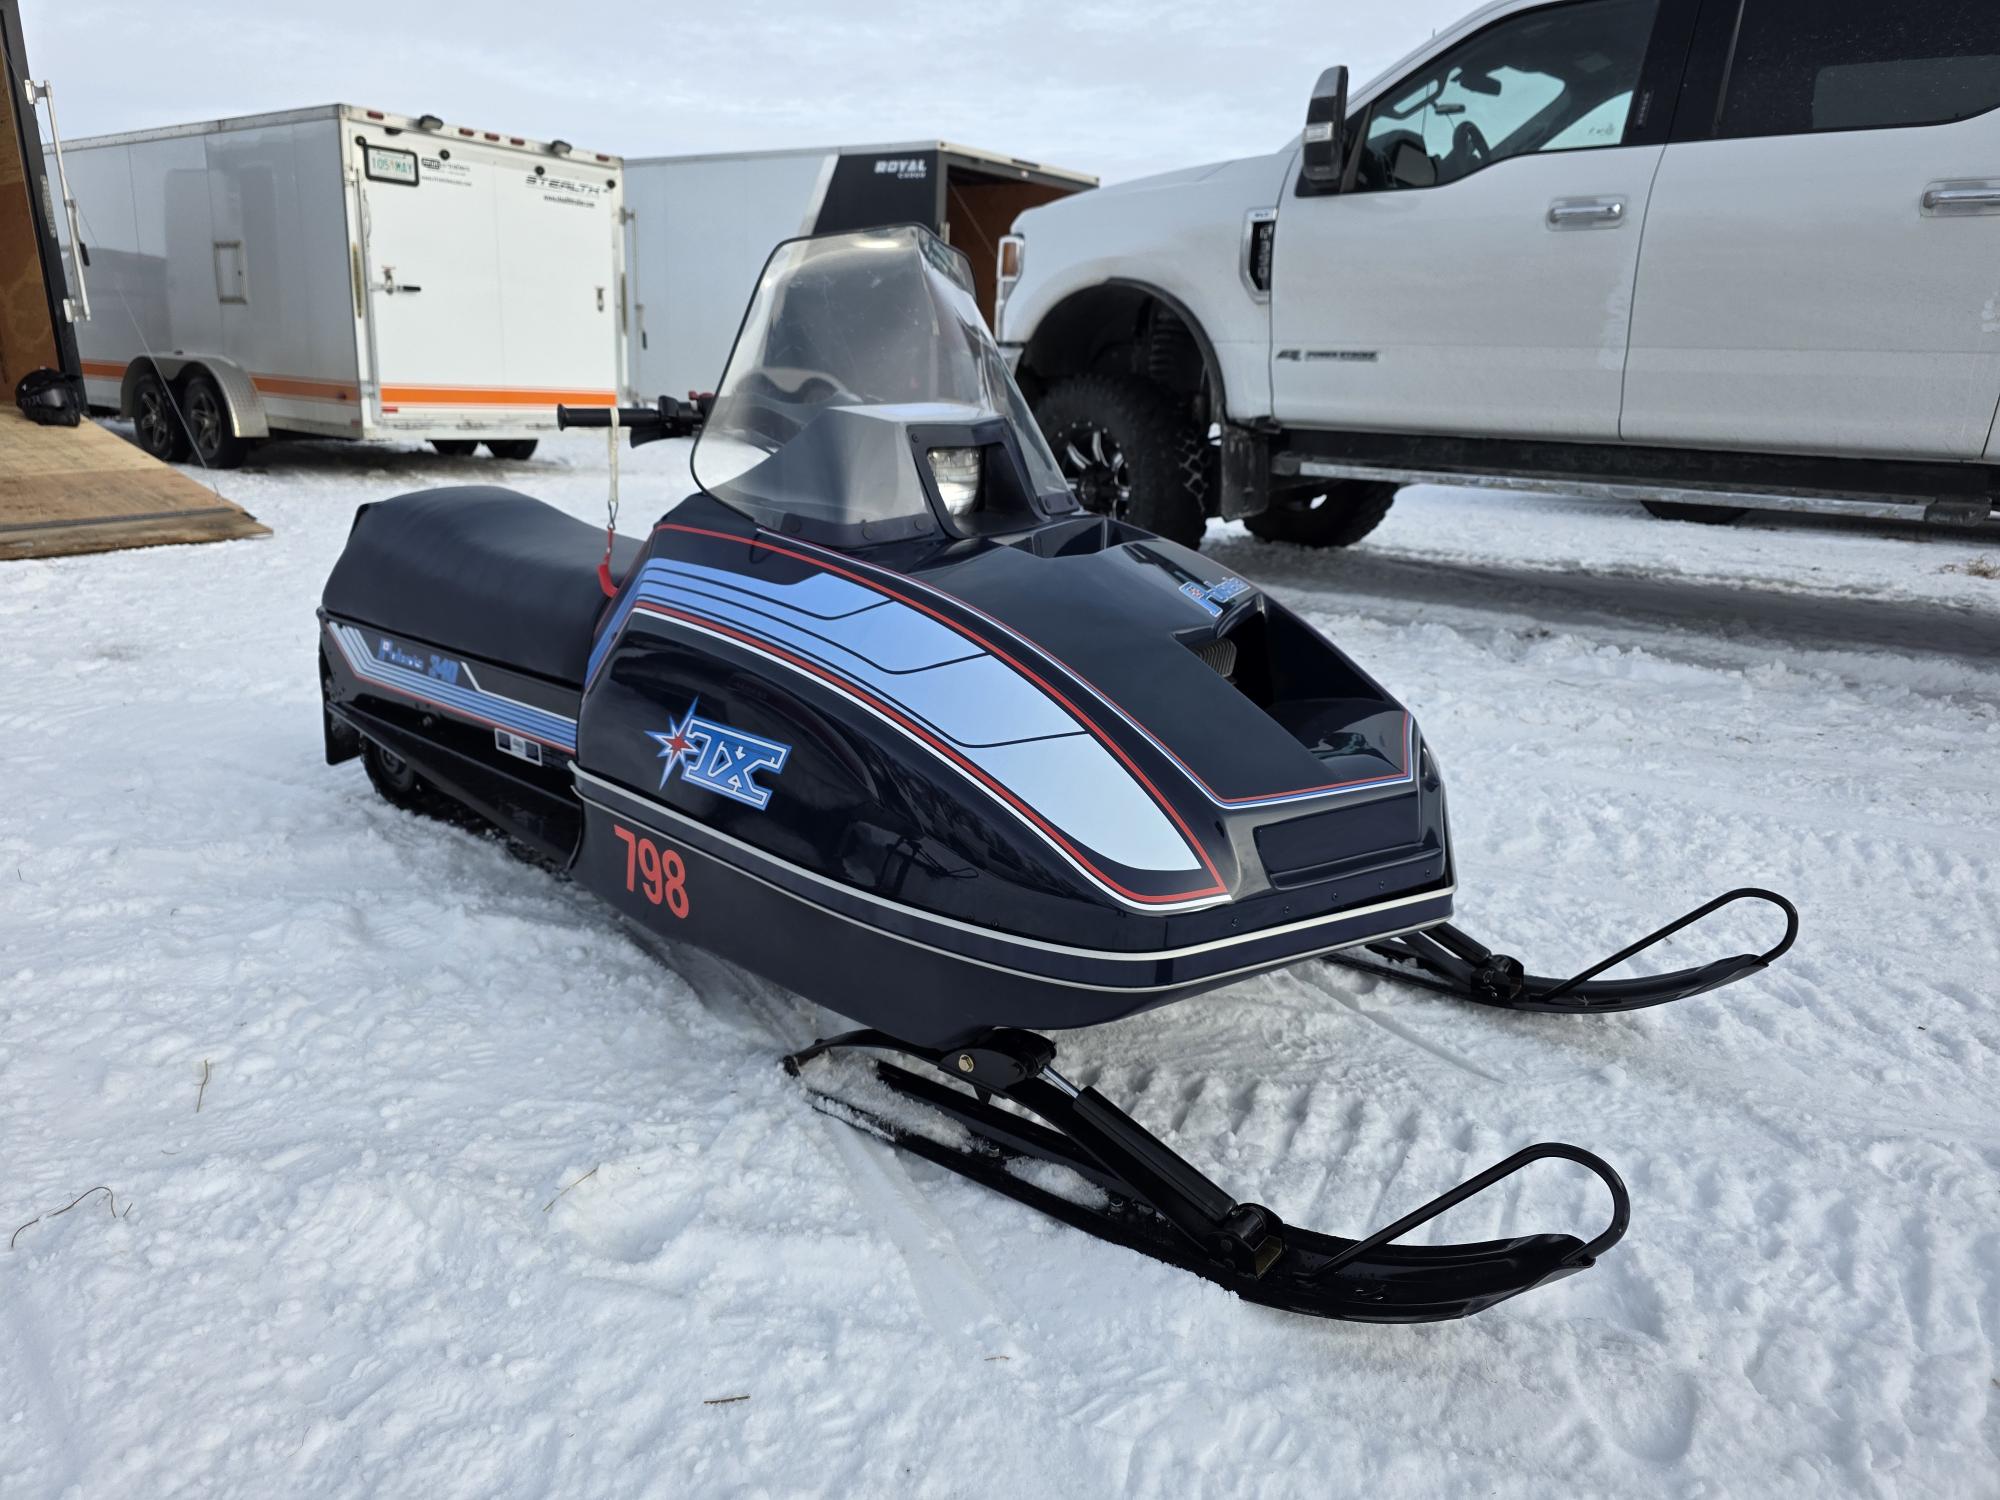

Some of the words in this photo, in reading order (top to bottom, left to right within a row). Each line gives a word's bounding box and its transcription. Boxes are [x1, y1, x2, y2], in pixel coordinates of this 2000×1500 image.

[874, 159, 927, 174] ROYAL
[526, 175, 601, 196] STEALTH
[613, 823, 690, 919] 798
